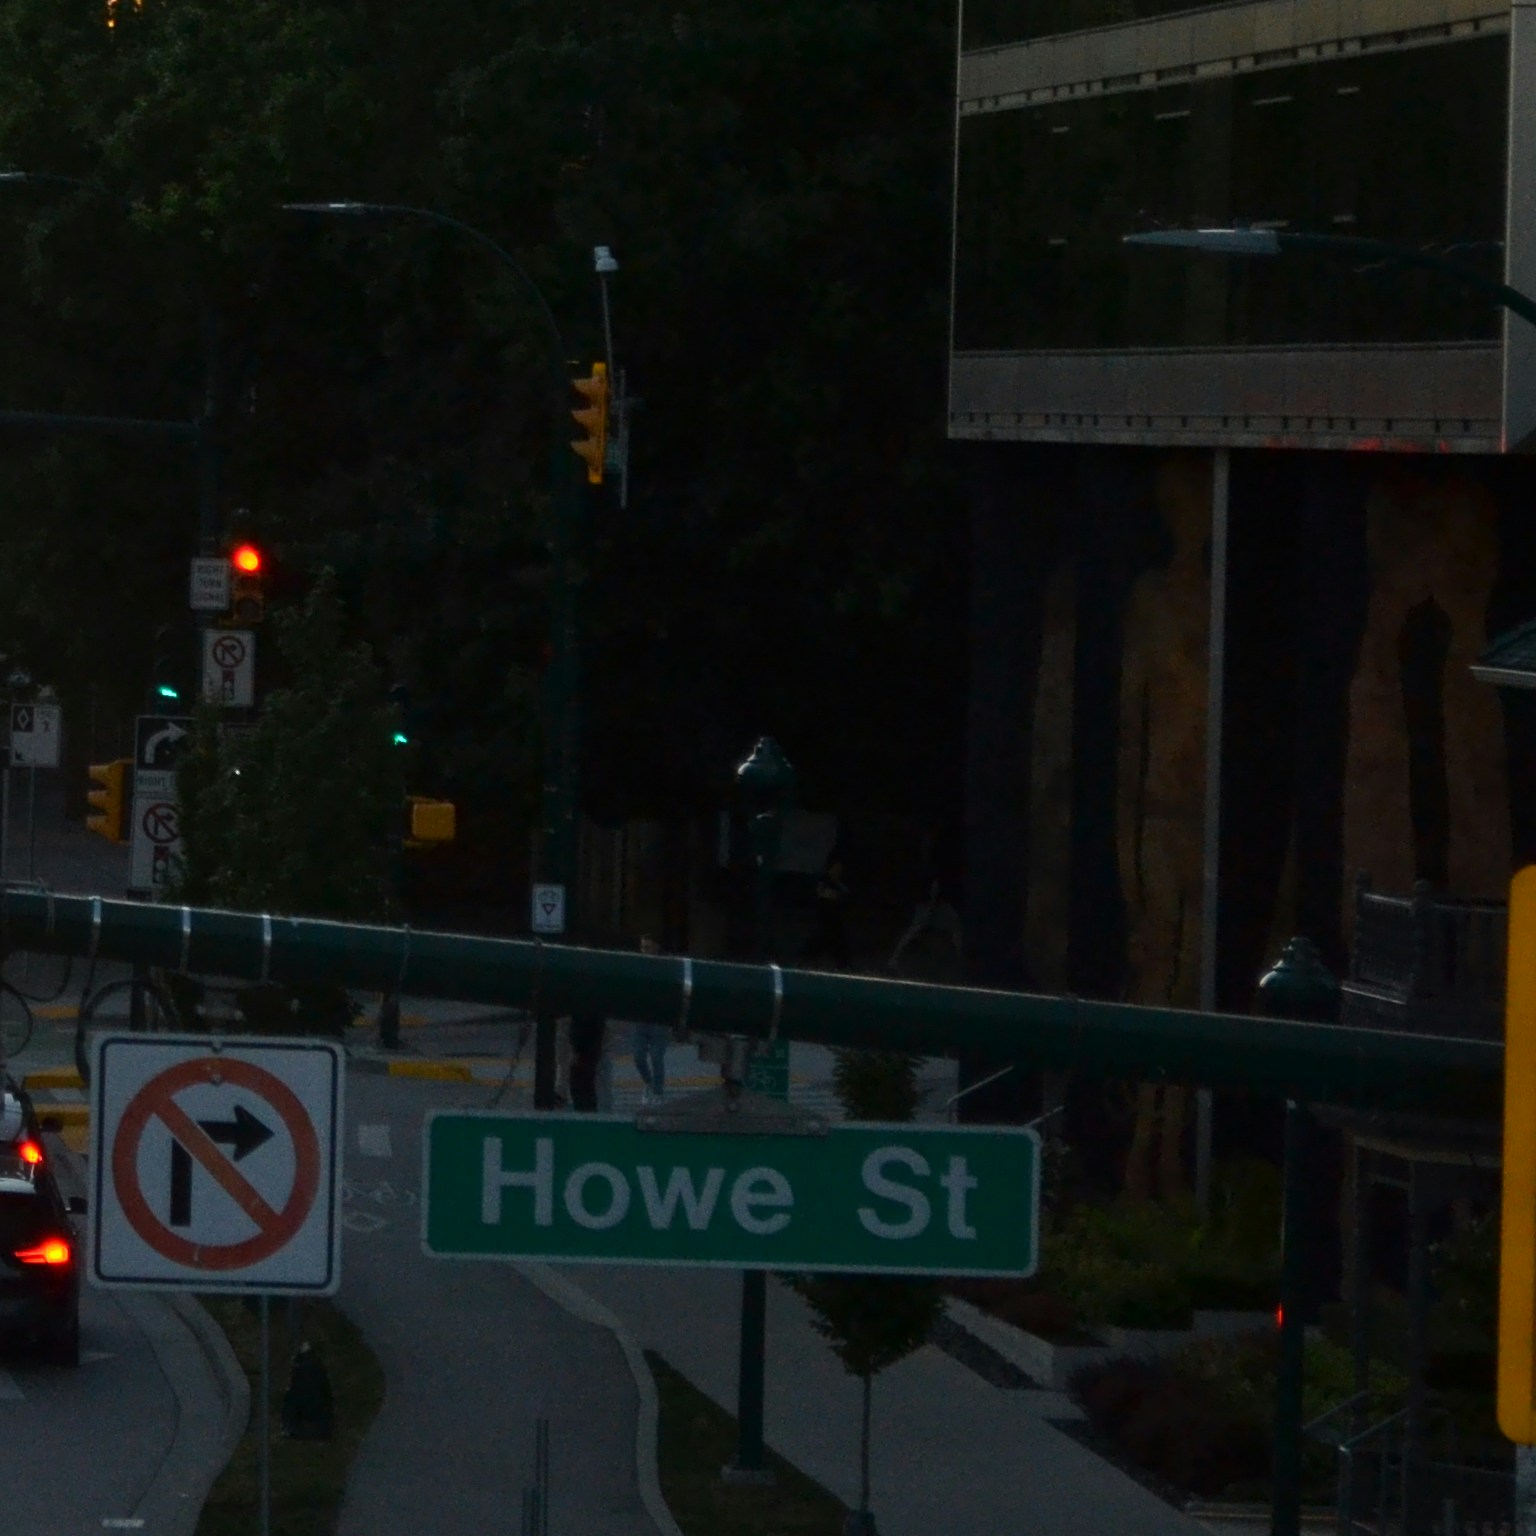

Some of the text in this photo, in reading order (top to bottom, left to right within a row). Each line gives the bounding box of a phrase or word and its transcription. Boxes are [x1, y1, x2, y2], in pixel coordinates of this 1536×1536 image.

[196, 564, 224, 574] RIGHT
[480, 1135, 978, 1241] Howe St
